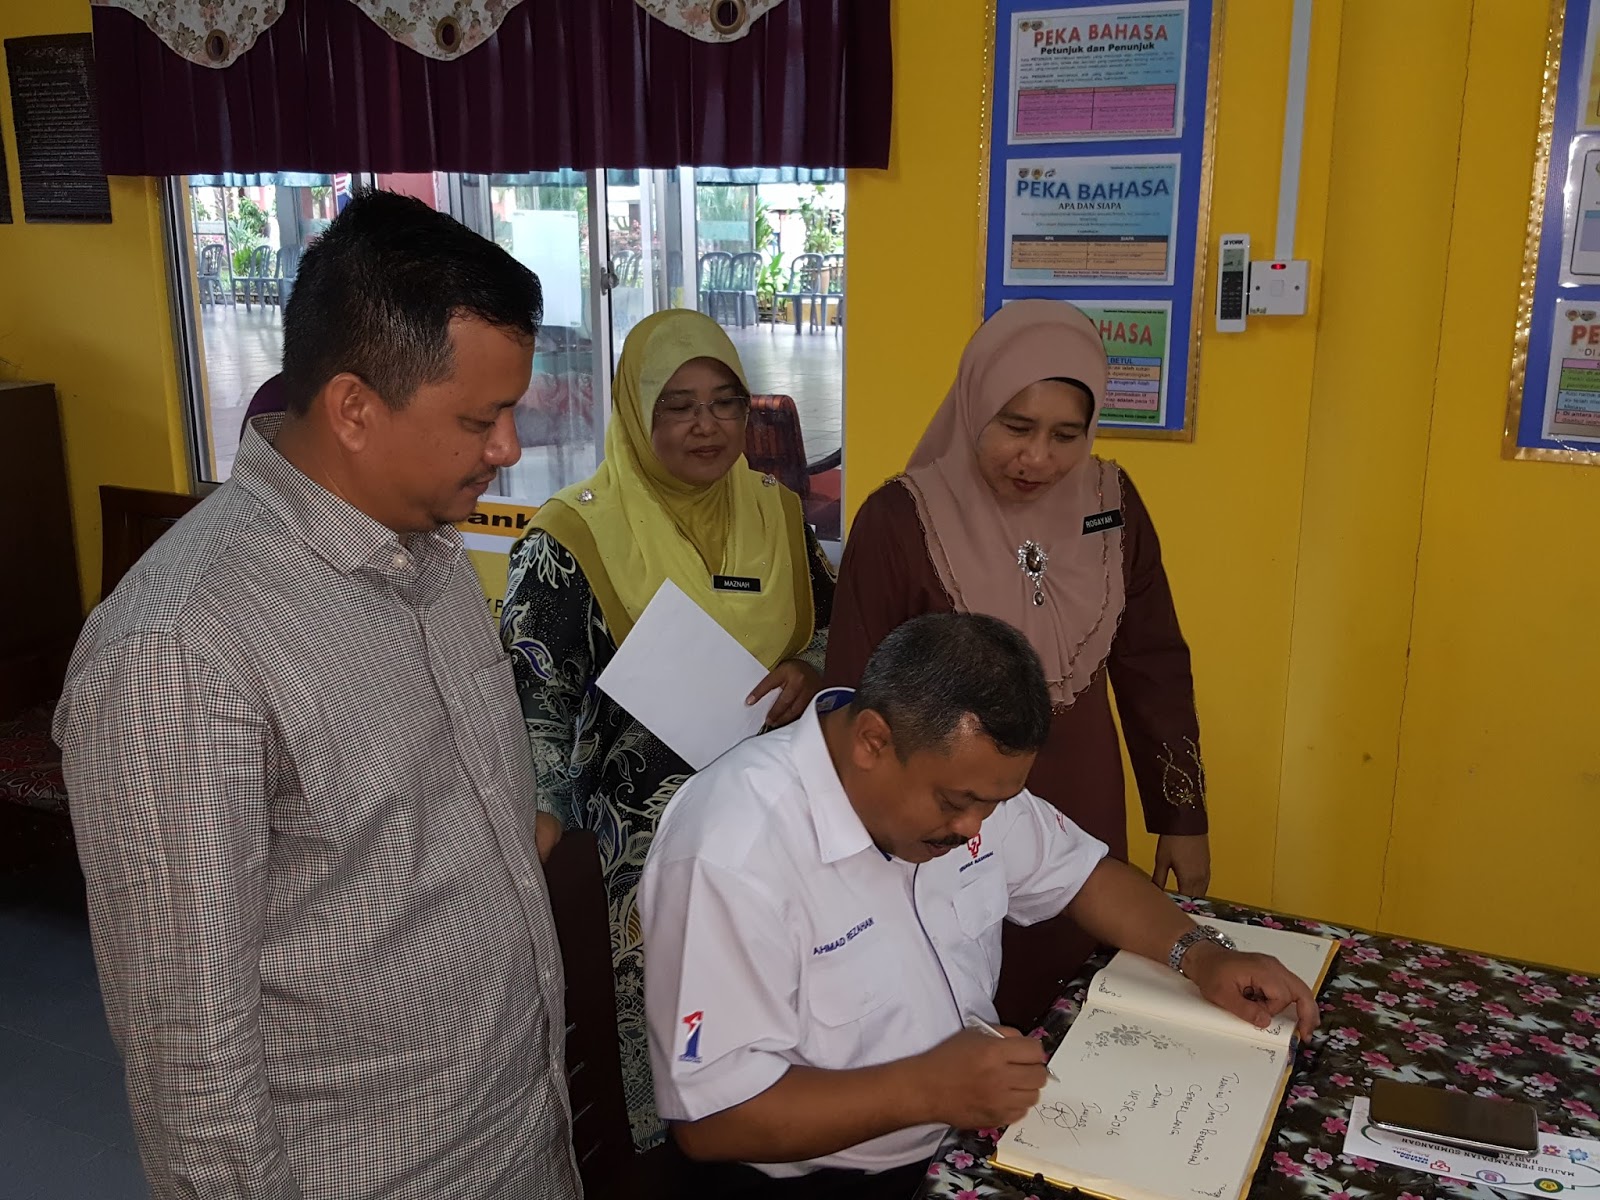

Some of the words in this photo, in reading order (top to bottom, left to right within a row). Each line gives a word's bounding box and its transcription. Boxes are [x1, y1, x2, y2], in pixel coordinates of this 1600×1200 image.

[1033, 27, 1081, 47] PEKA
[1088, 23, 1168, 42] BAHASA
[1040, 45, 1084, 55] Petunjuk
[1087, 44, 1105, 53] dan
[1108, 41, 1155, 52] Penunjuk
[1016, 180, 1070, 200] PEKA
[1078, 179, 1169, 200] BAHASA
[1058, 202, 1075, 210] APA
[1077, 202, 1095, 210] DAN
[1097, 202, 1122, 210] SIAPA
[1090, 319, 1153, 346] HASA
[724, 580, 750, 588] MAZNAH
[813, 937, 846, 955] AHMAD
[1119, 1089, 1142, 1113] UPSR
[1106, 1115, 1128, 1137] 2016
[1402, 1138, 1461, 1155] SUMBANGAN
[1463, 1151, 1534, 1170] PENYAMPAIAN
[1538, 1166, 1575, 1177] MAJLIS
